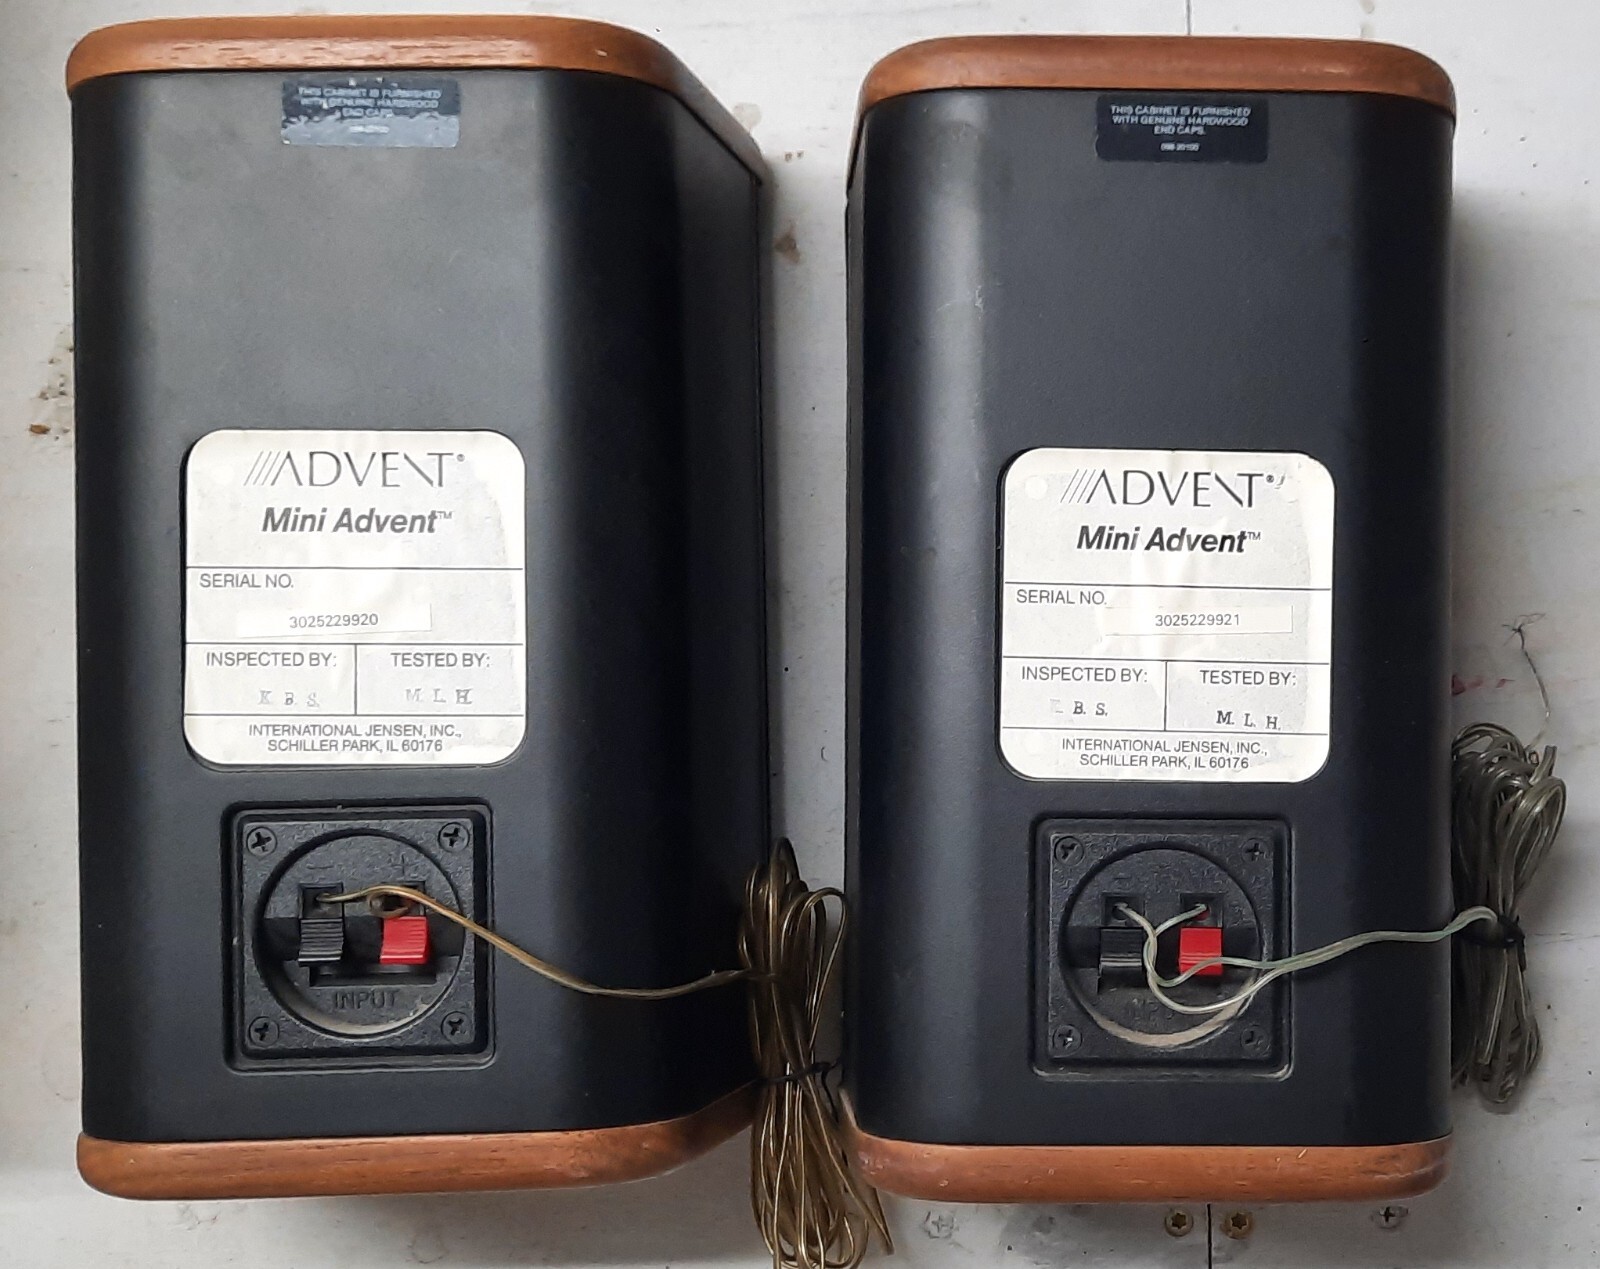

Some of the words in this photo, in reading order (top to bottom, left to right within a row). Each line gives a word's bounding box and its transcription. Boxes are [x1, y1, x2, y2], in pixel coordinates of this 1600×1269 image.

[261, 506, 328, 533] Mini
[1076, 525, 1141, 551] Mini
[199, 573, 262, 589] SERIAL
[264, 573, 294, 589] NO.
[1016, 589, 1076, 605] SERIAL
[1078, 590, 1107, 606] NO.
[288, 612, 379, 630] 3025229920
[1154, 613, 1241, 627] 3025229921
[206, 651, 305, 668] INSPECTED
[308, 651, 337, 668] BY:
[390, 652, 458, 668] TESTED
[461, 653, 490, 668] BY:
[1021, 665, 1117, 683] INSPECTED
[1120, 667, 1148, 684] BY:
[1199, 669, 1265, 686] TESTED
[1268, 671, 1297, 687] BY:
[248, 723, 363, 737] INTERNATIONAL
[364, 724, 427, 740] JENSEN,
[267, 739, 339, 753] SCHILLER
[341, 739, 384, 754] PARK,
[386, 739, 399, 752] IL
[401, 739, 443, 753] 60176
[1061, 737, 1172, 754] INTERNATIONAL
[1173, 740, 1235, 756] JENSEN,
[1236, 742, 1268, 756] INC.,
[1079, 754, 1149, 768] SCHILLER
[1151, 755, 1191, 770] PARK,
[1194, 757, 1206, 769] IL
[1208, 757, 1250, 770] 60176
[334, 990, 399, 1010] INPUT
